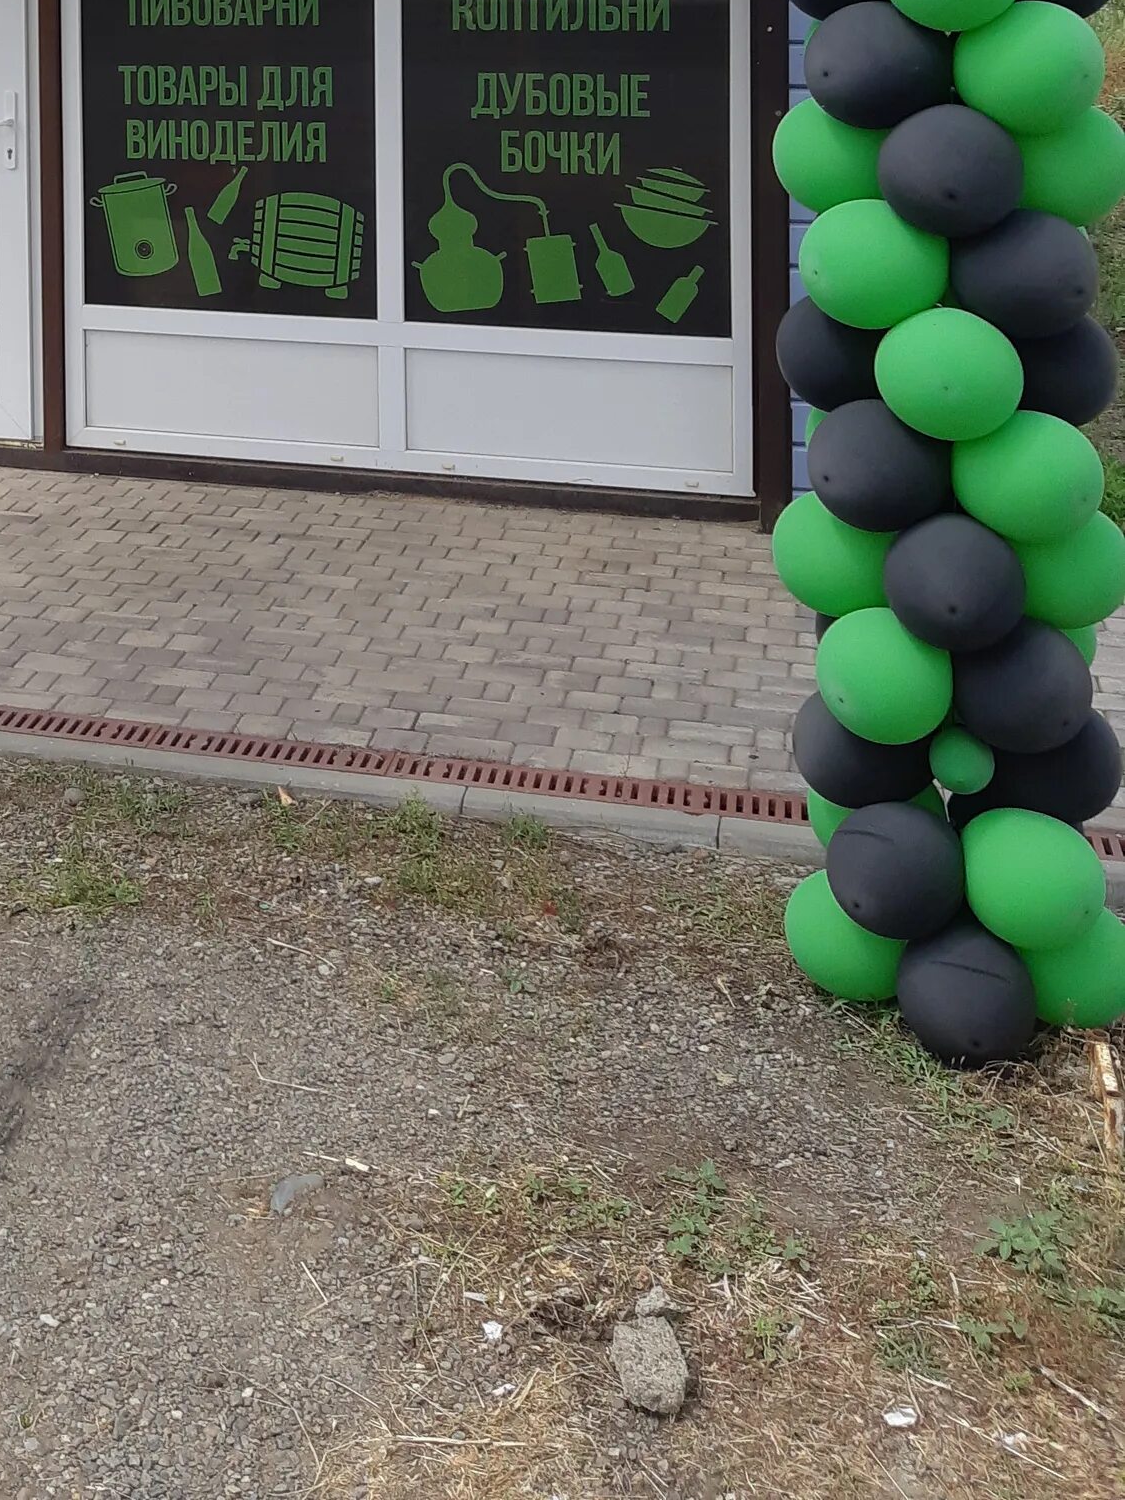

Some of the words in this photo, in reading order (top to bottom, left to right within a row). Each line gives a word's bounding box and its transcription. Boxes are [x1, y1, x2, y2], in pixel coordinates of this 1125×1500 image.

[118, 65, 247, 106] ТОВАРЫ
[257, 66, 333, 110] ДЛЯ
[471, 71, 651, 118] ДУБОВЫЕ
[126, 118, 327, 164] ВИНОДЕЛИЯ
[500, 130, 621, 175] БОЧКИ
